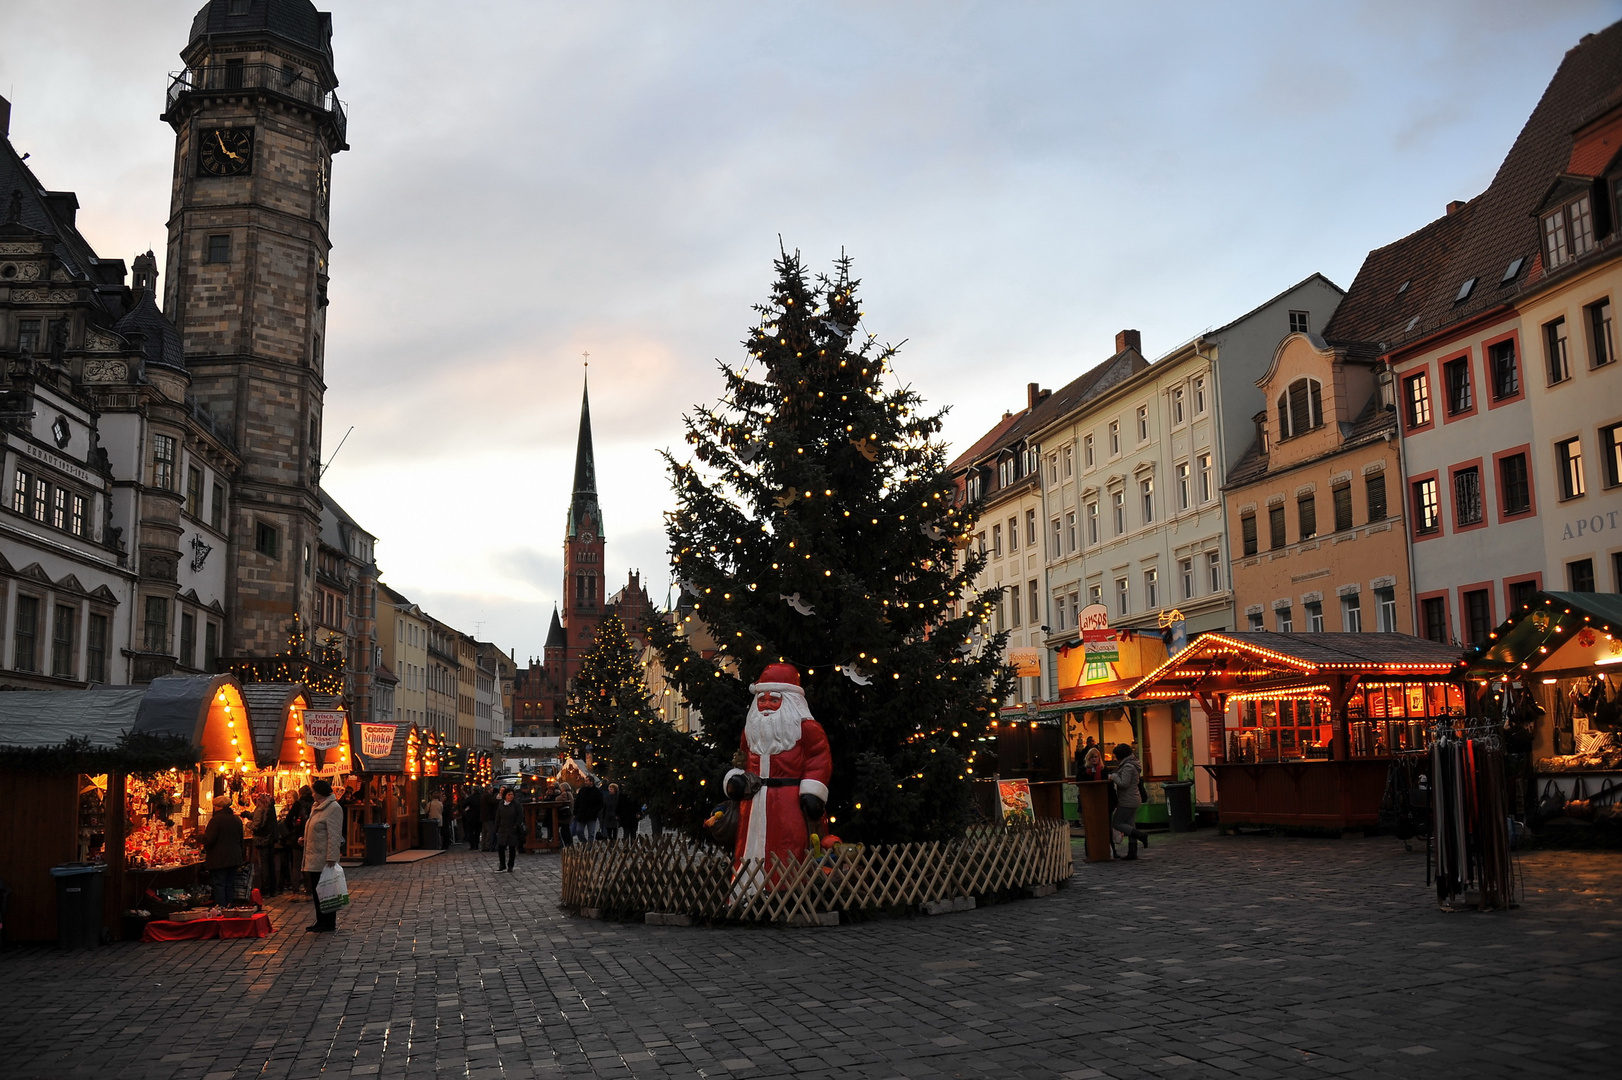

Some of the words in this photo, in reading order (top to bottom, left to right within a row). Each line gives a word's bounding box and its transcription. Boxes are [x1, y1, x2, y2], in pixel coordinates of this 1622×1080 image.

[26, 444, 58, 466] ERBAUT
[1562, 510, 1619, 541] APOT
[305, 723, 342, 737] Mandeln
[364, 732, 393, 744] Schoko-
[364, 743, 389, 755] früchte
